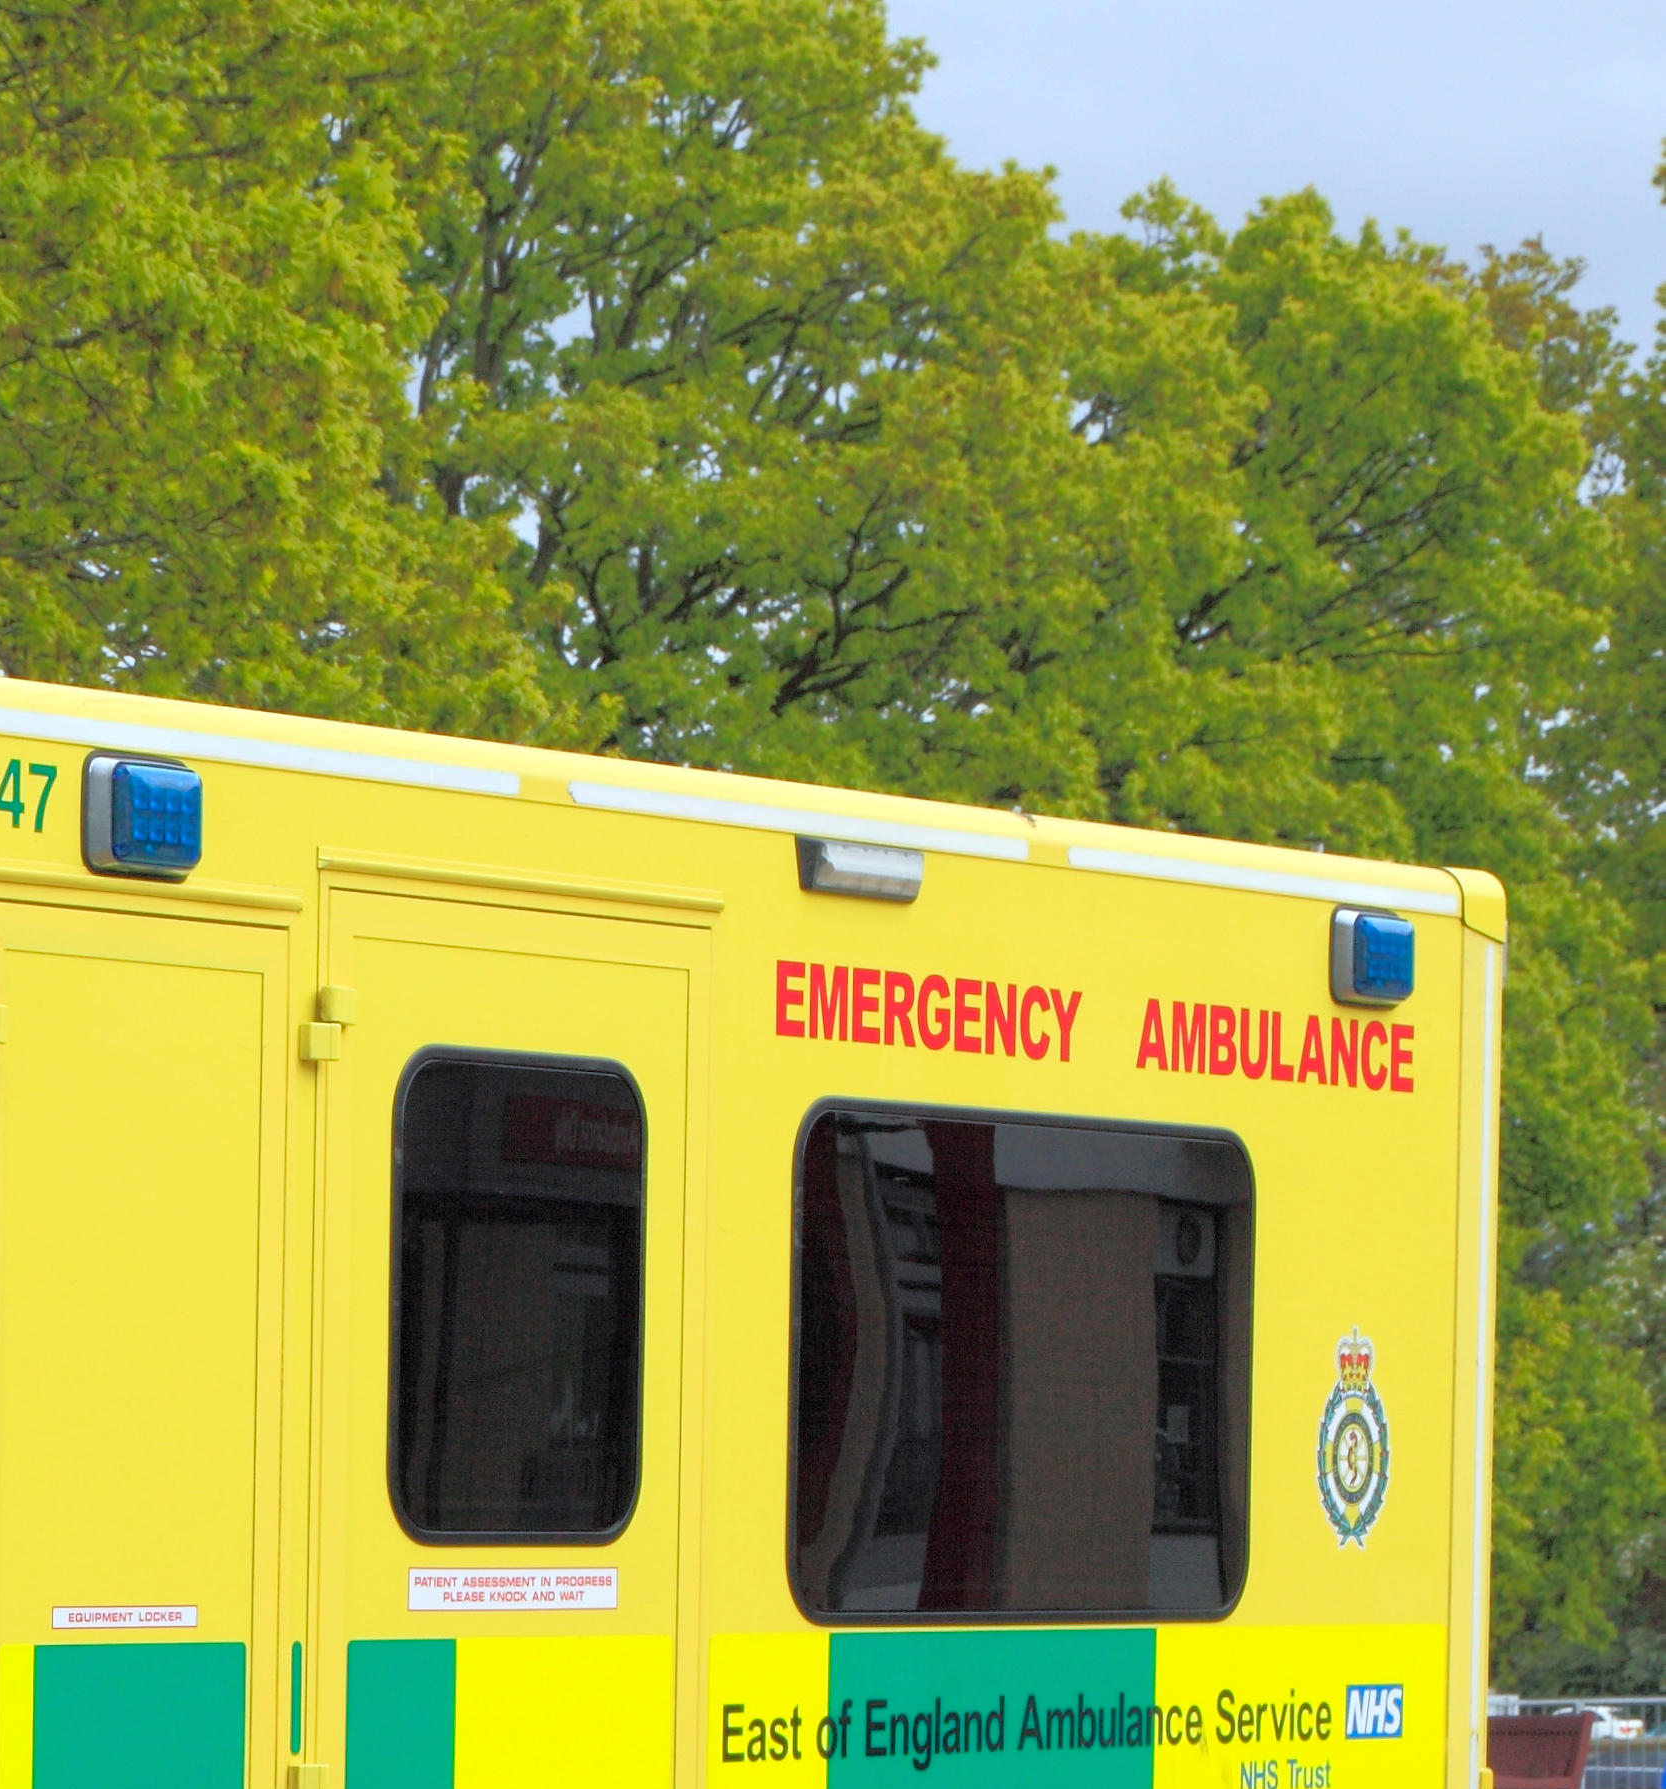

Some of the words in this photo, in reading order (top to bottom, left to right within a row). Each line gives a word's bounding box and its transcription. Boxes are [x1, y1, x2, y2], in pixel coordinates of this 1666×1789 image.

[775, 959, 1083, 1064] EMERGENCY
[1135, 997, 1415, 1094] AMBULANCE
[414, 1576, 458, 1588] PATIENT
[462, 1576, 537, 1588] ASSESSMENT
[541, 1576, 551, 1587] IN
[556, 1575, 613, 1587] PROGRESS
[443, 1591, 485, 1602] PLEASE
[489, 1591, 527, 1602] KNOCK
[532, 1591, 555, 1601] AND
[560, 1590, 585, 1601] WAIT
[68, 1612, 134, 1623] EQUIPMENT
[138, 1611, 182, 1622] LOCKER
[1346, 1687, 1403, 1736] NHS
[721, 1703, 802, 1763] East
[817, 1701, 853, 1760] of
[868, 1696, 1005, 1771] England
[1018, 1692, 1204, 1751] Ambulance
[1216, 1688, 1332, 1745] Service
[1287, 1758, 1331, 1789] Trust
